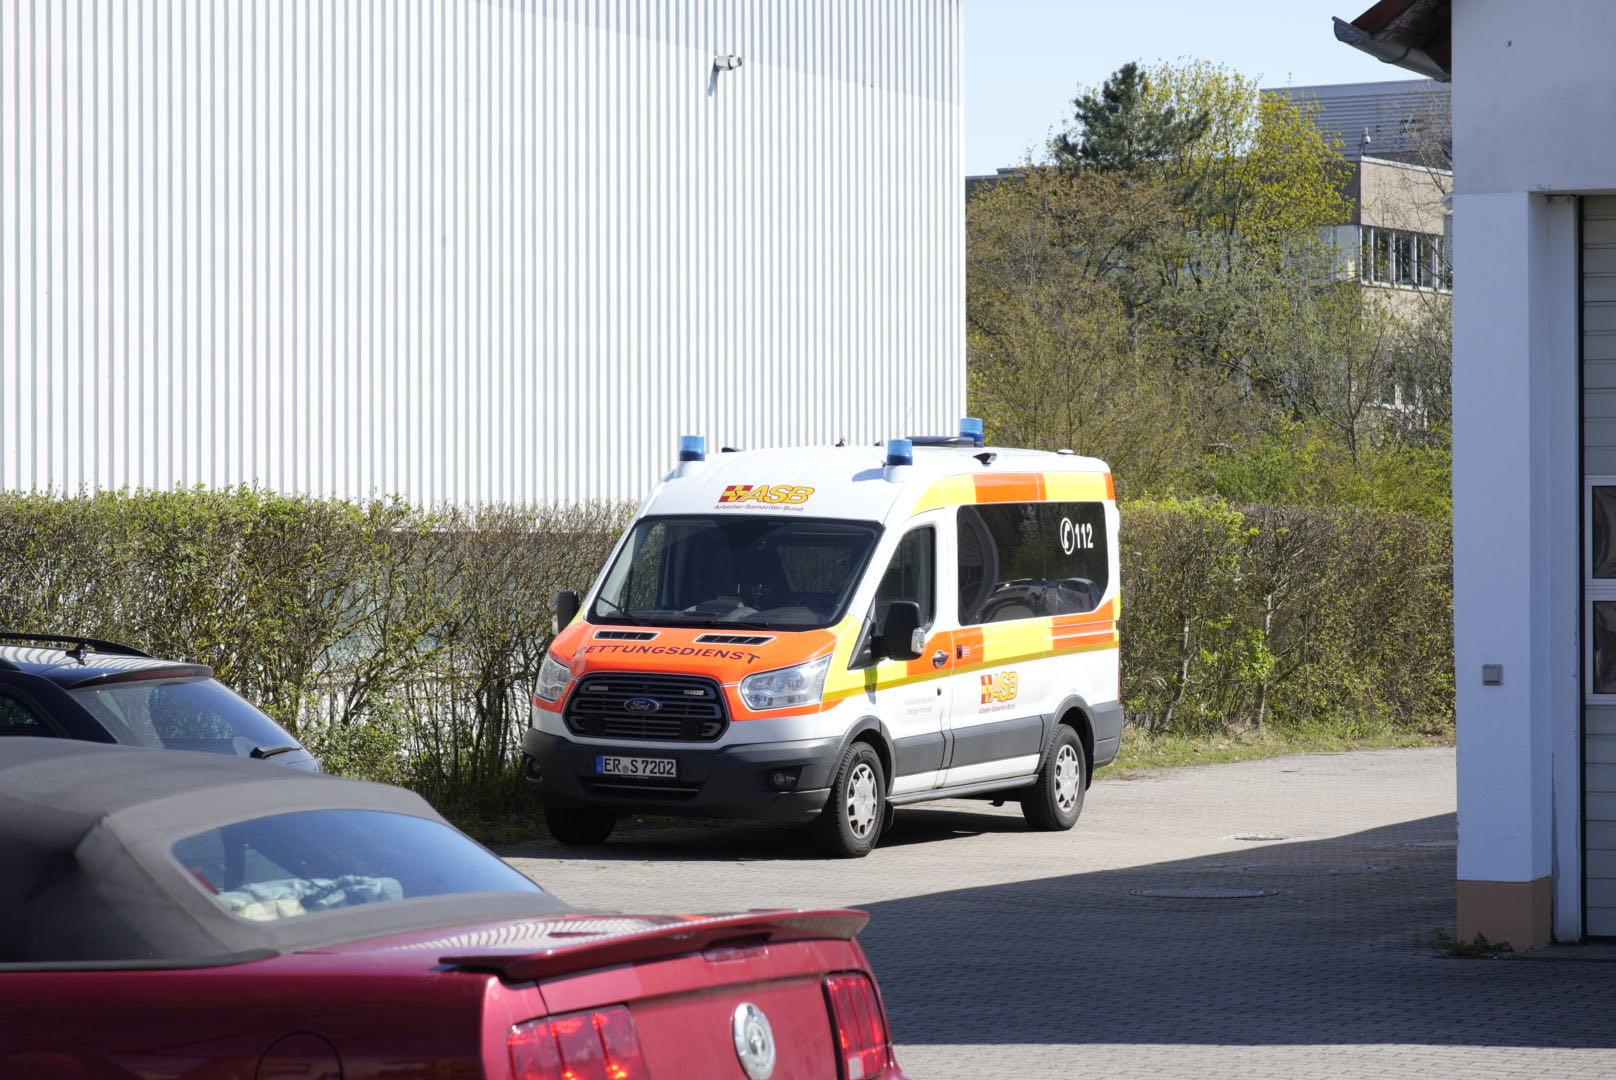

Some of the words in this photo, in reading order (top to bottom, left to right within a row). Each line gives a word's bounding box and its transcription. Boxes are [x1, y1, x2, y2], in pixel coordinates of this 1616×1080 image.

[739, 485, 815, 504] ASB
[1075, 523, 1094, 549] 112
[993, 671, 1018, 702] ASB
[630, 700, 650, 711] Ford
[604, 758, 621, 773] ER
[630, 759, 639, 774] S
[641, 760, 675, 776] 7202
